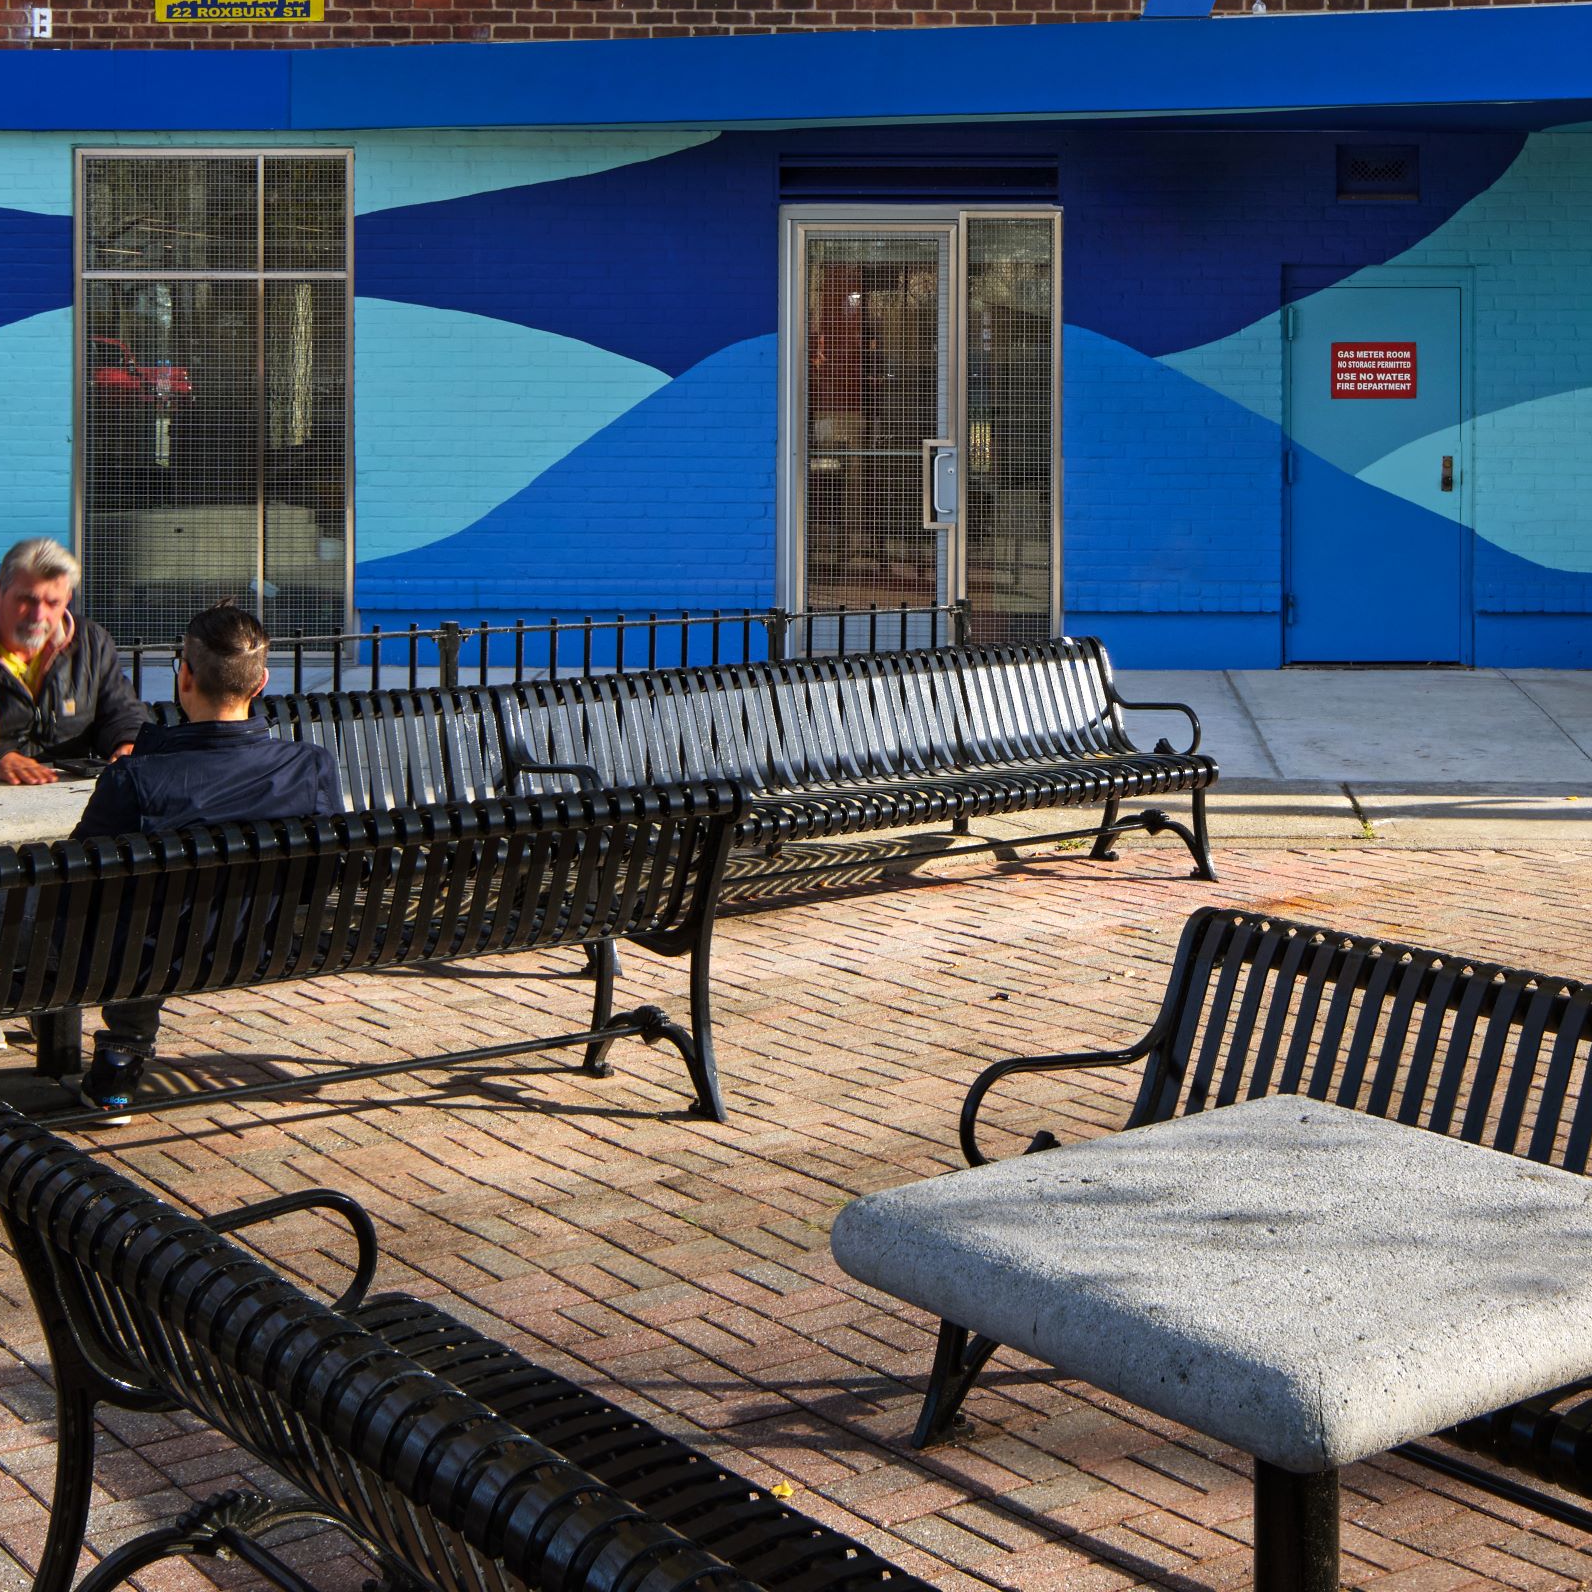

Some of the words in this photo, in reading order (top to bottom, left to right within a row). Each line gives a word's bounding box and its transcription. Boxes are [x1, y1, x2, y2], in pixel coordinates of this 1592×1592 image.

[171, 7, 192, 17] 22
[197, 7, 277, 17] ROXBURY
[283, 7, 307, 17] ST.
